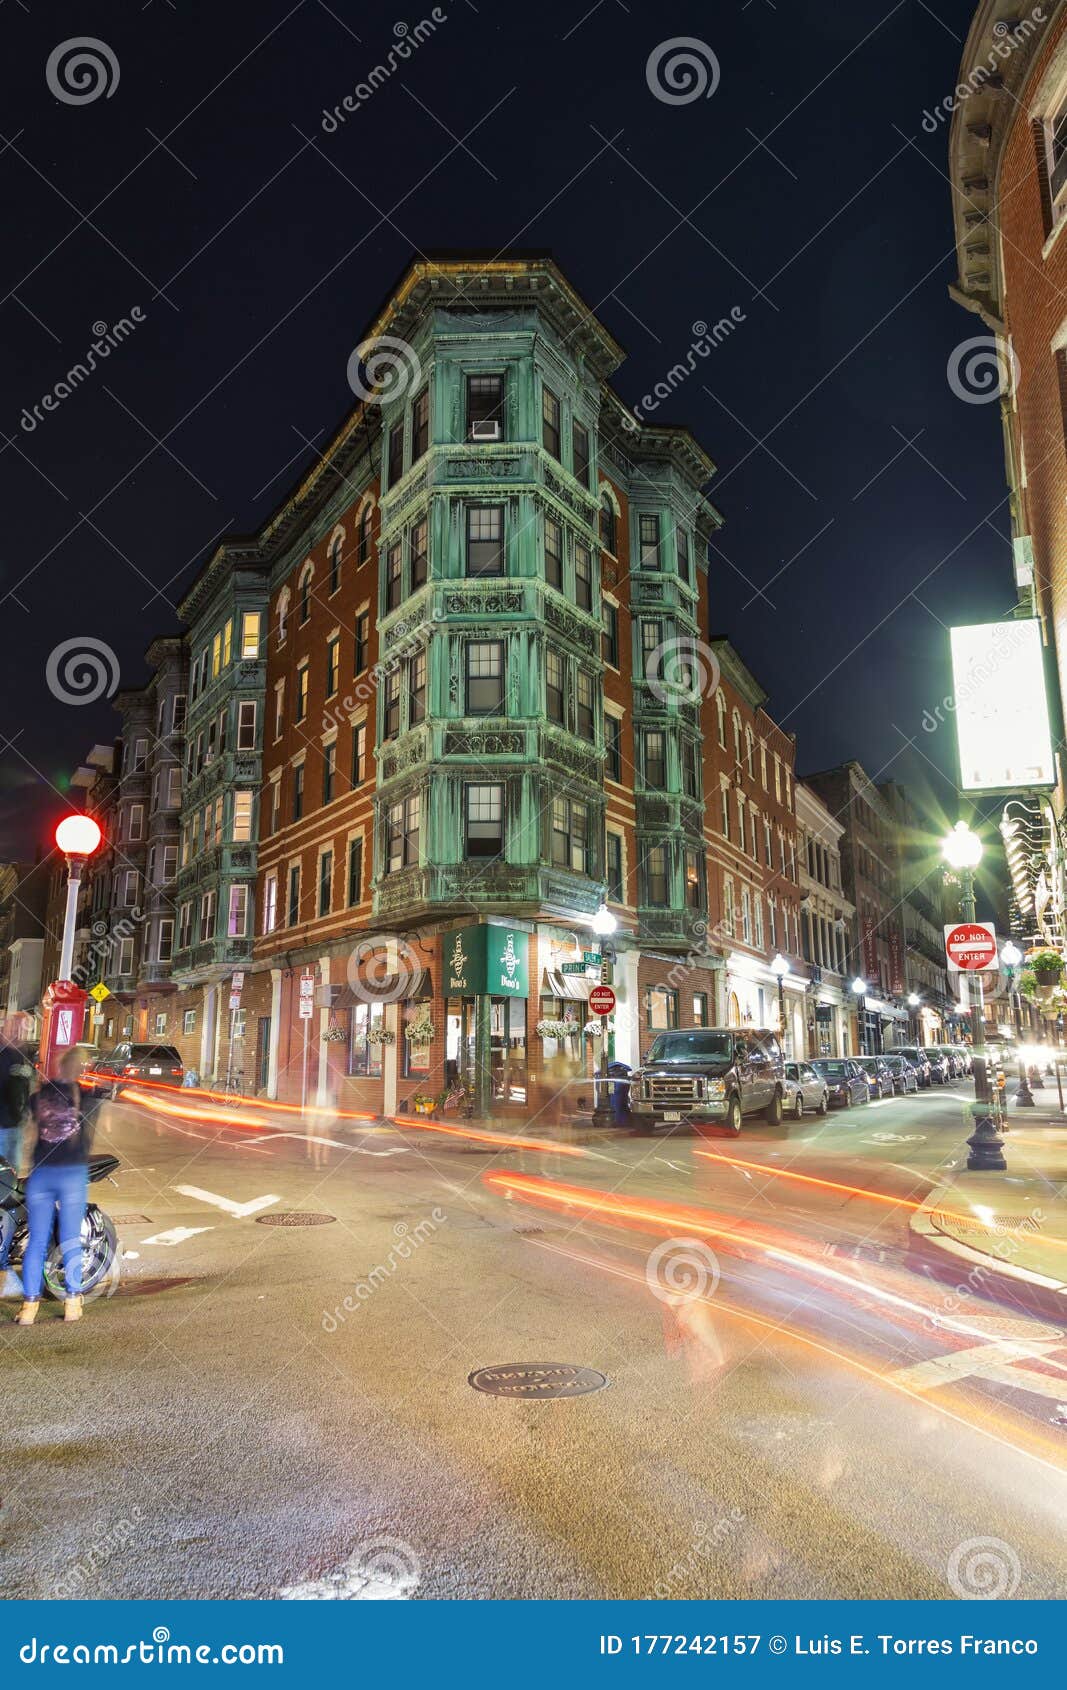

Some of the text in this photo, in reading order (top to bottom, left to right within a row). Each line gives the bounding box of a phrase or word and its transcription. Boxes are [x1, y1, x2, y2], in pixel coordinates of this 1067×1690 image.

[970, 933, 986, 941] NOT
[563, 963, 585, 973] PRINC
[450, 977, 467, 988] Dino's
[501, 975, 520, 989] Dino's
